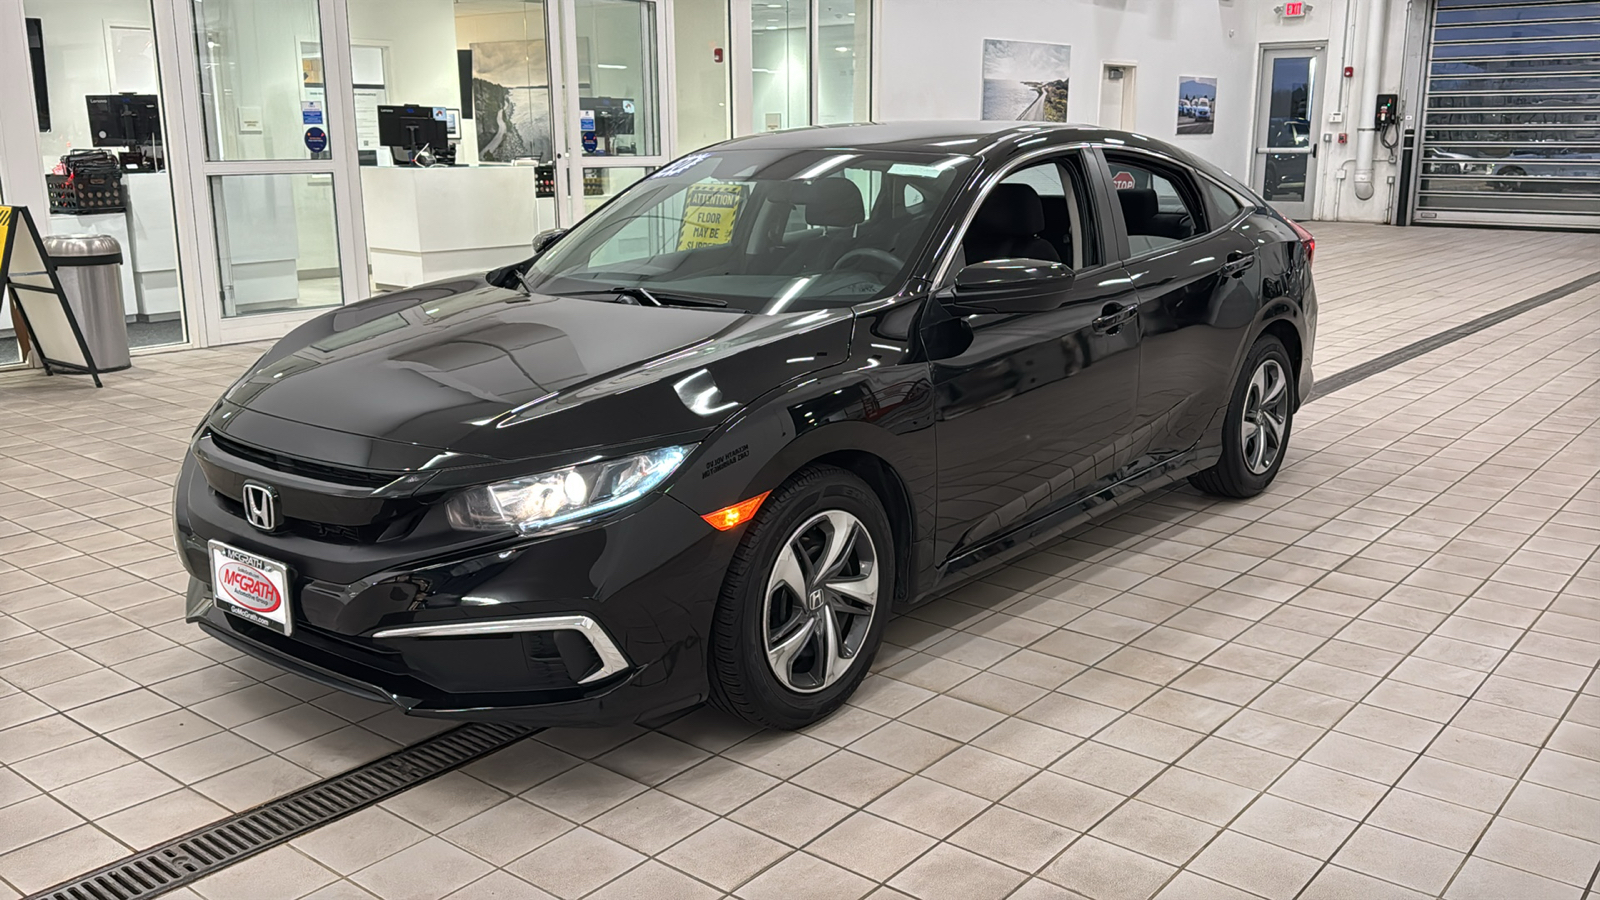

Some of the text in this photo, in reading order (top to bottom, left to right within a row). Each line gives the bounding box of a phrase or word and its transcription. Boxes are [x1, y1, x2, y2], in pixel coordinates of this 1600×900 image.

[1286, 2, 1302, 16] EXIT
[692, 194, 734, 206] ATTENTION
[697, 212, 722, 224] FLOOR
[693, 227, 720, 239] MAY BE
[231, 605, 269, 626] GoMcGrath.com
